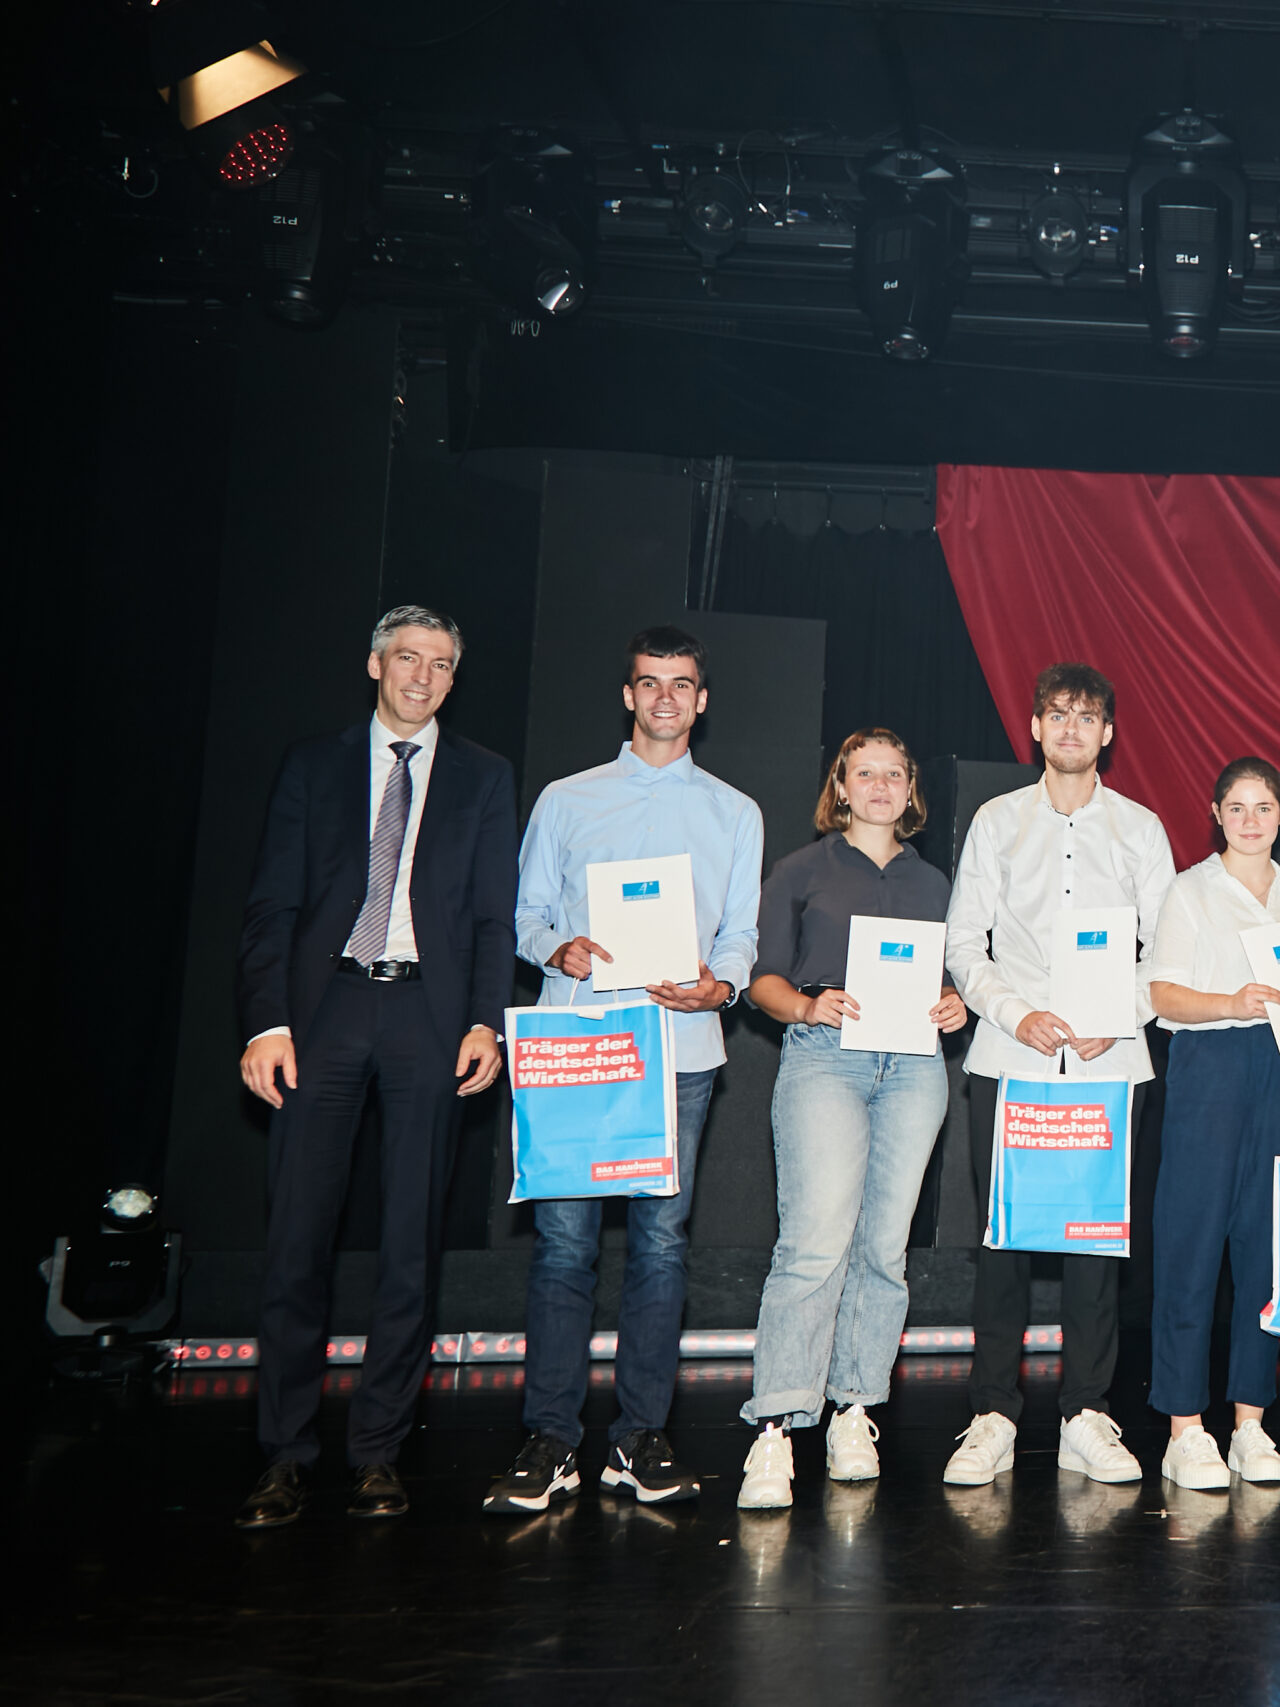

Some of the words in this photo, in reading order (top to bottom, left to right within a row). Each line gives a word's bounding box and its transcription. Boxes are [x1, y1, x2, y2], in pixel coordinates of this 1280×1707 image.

[272, 215, 298, 226] P12
[1176, 254, 1199, 264] P12
[518, 1041, 590, 1057] Träger
[595, 1038, 632, 1052] der
[518, 1053, 636, 1070] deutschen
[518, 1066, 642, 1085] Wirtschaft.
[1008, 1105, 1066, 1122] Träger
[1070, 1107, 1103, 1120] der
[1008, 1119, 1106, 1134] deutschen
[1008, 1133, 1110, 1147] Wirtschaft.
